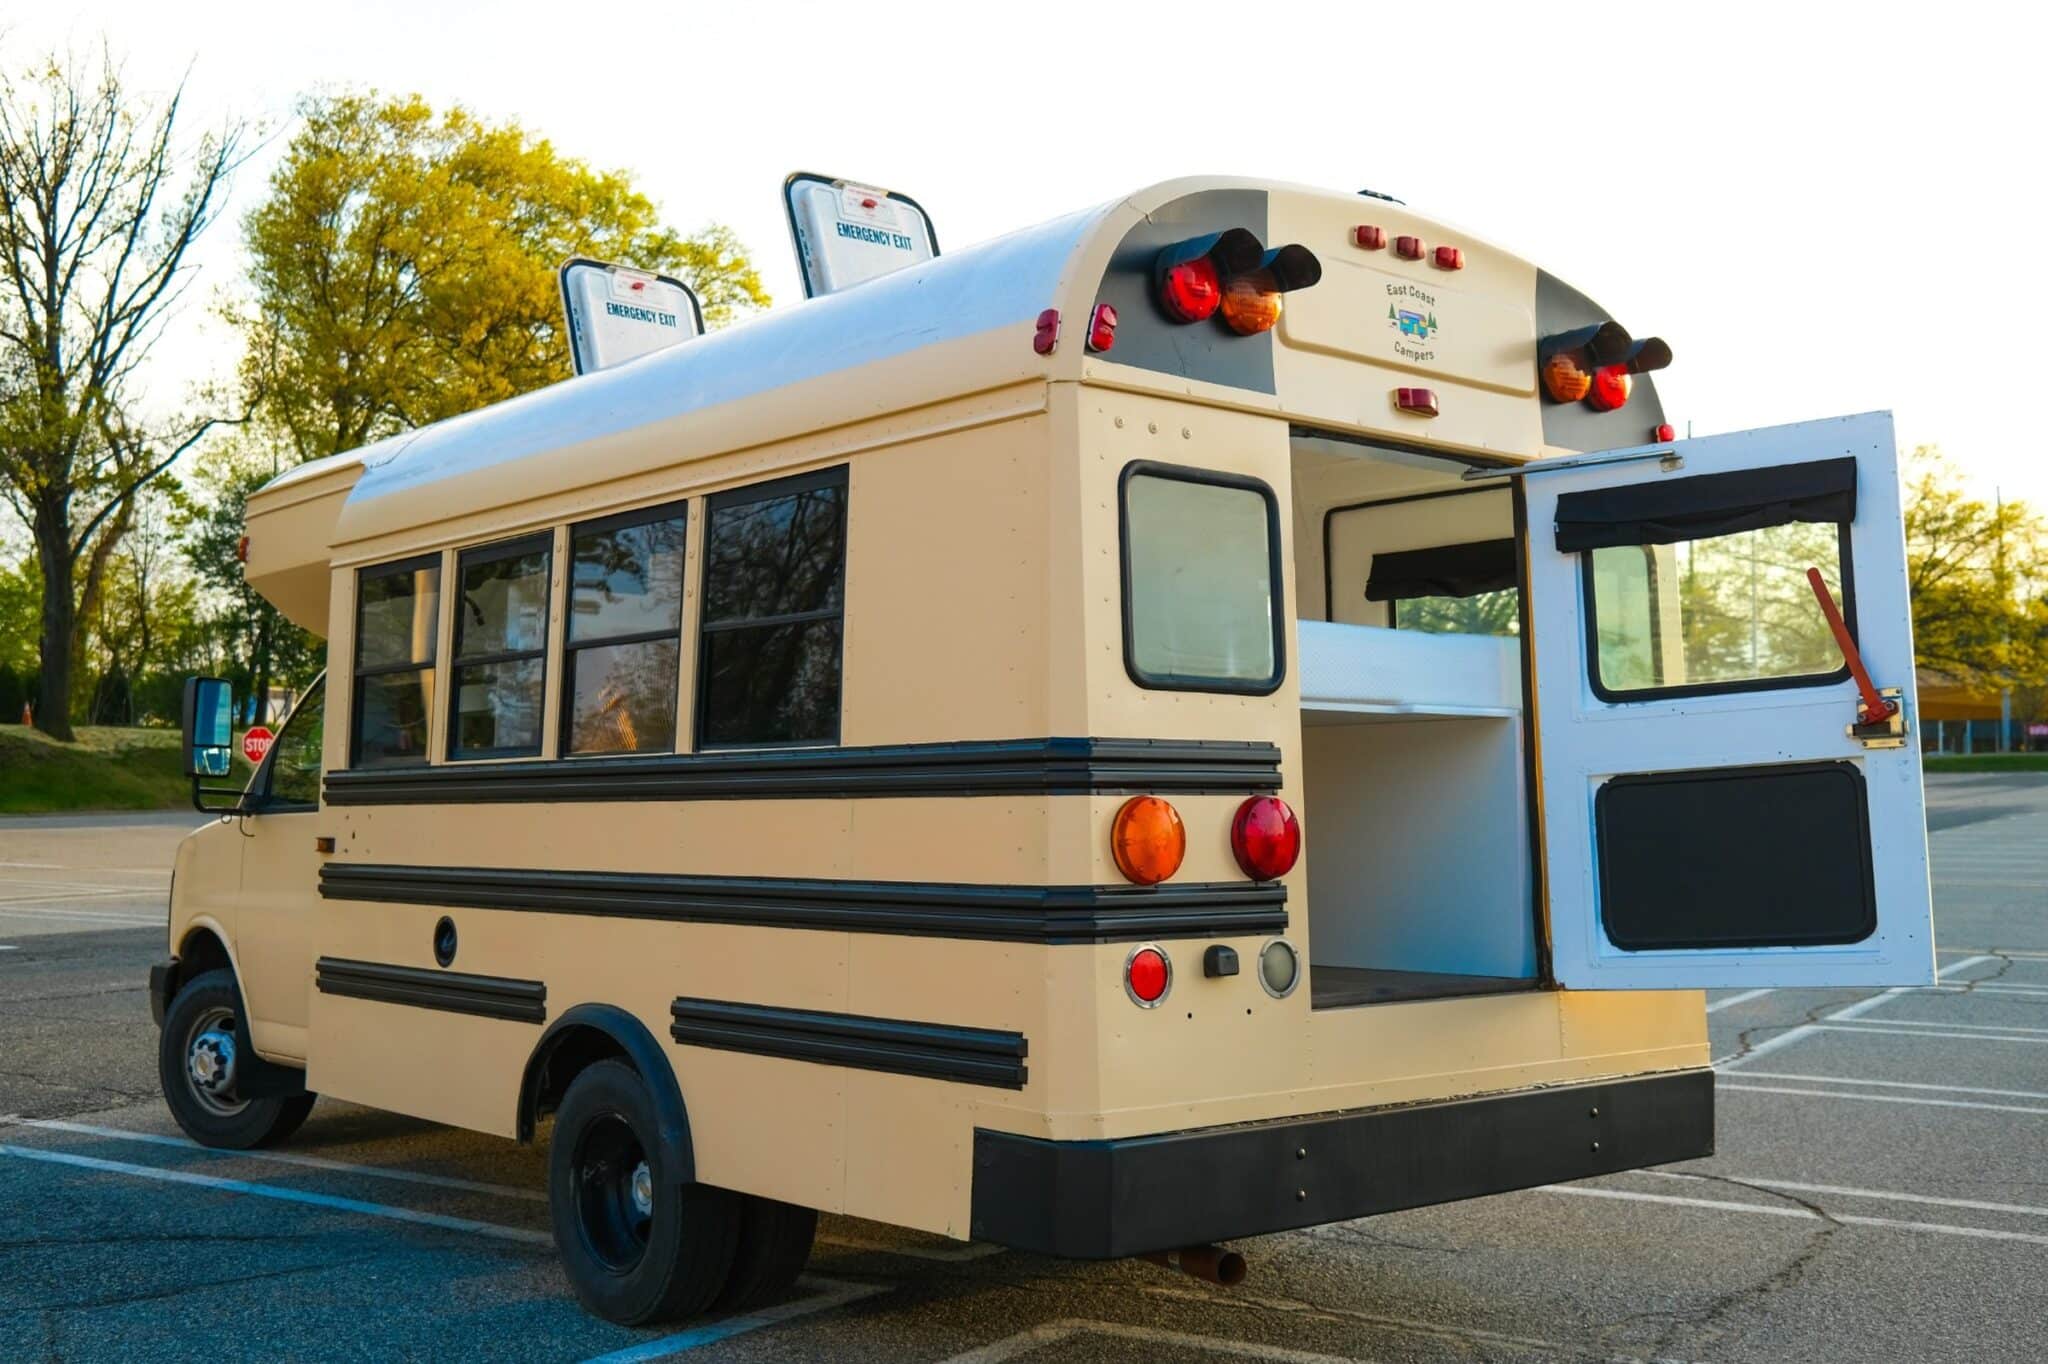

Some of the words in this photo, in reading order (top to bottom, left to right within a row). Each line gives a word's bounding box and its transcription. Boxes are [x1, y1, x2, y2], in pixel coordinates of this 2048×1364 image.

[837, 222, 890, 246] EMERGENCY
[893, 234, 912, 251] EXIT
[1386, 284, 1407, 295] East
[1409, 285, 1435, 306] Coast
[606, 302, 656, 323] EMERGENCY
[659, 313, 676, 328] EXIT
[1394, 341, 1434, 361] Campers
